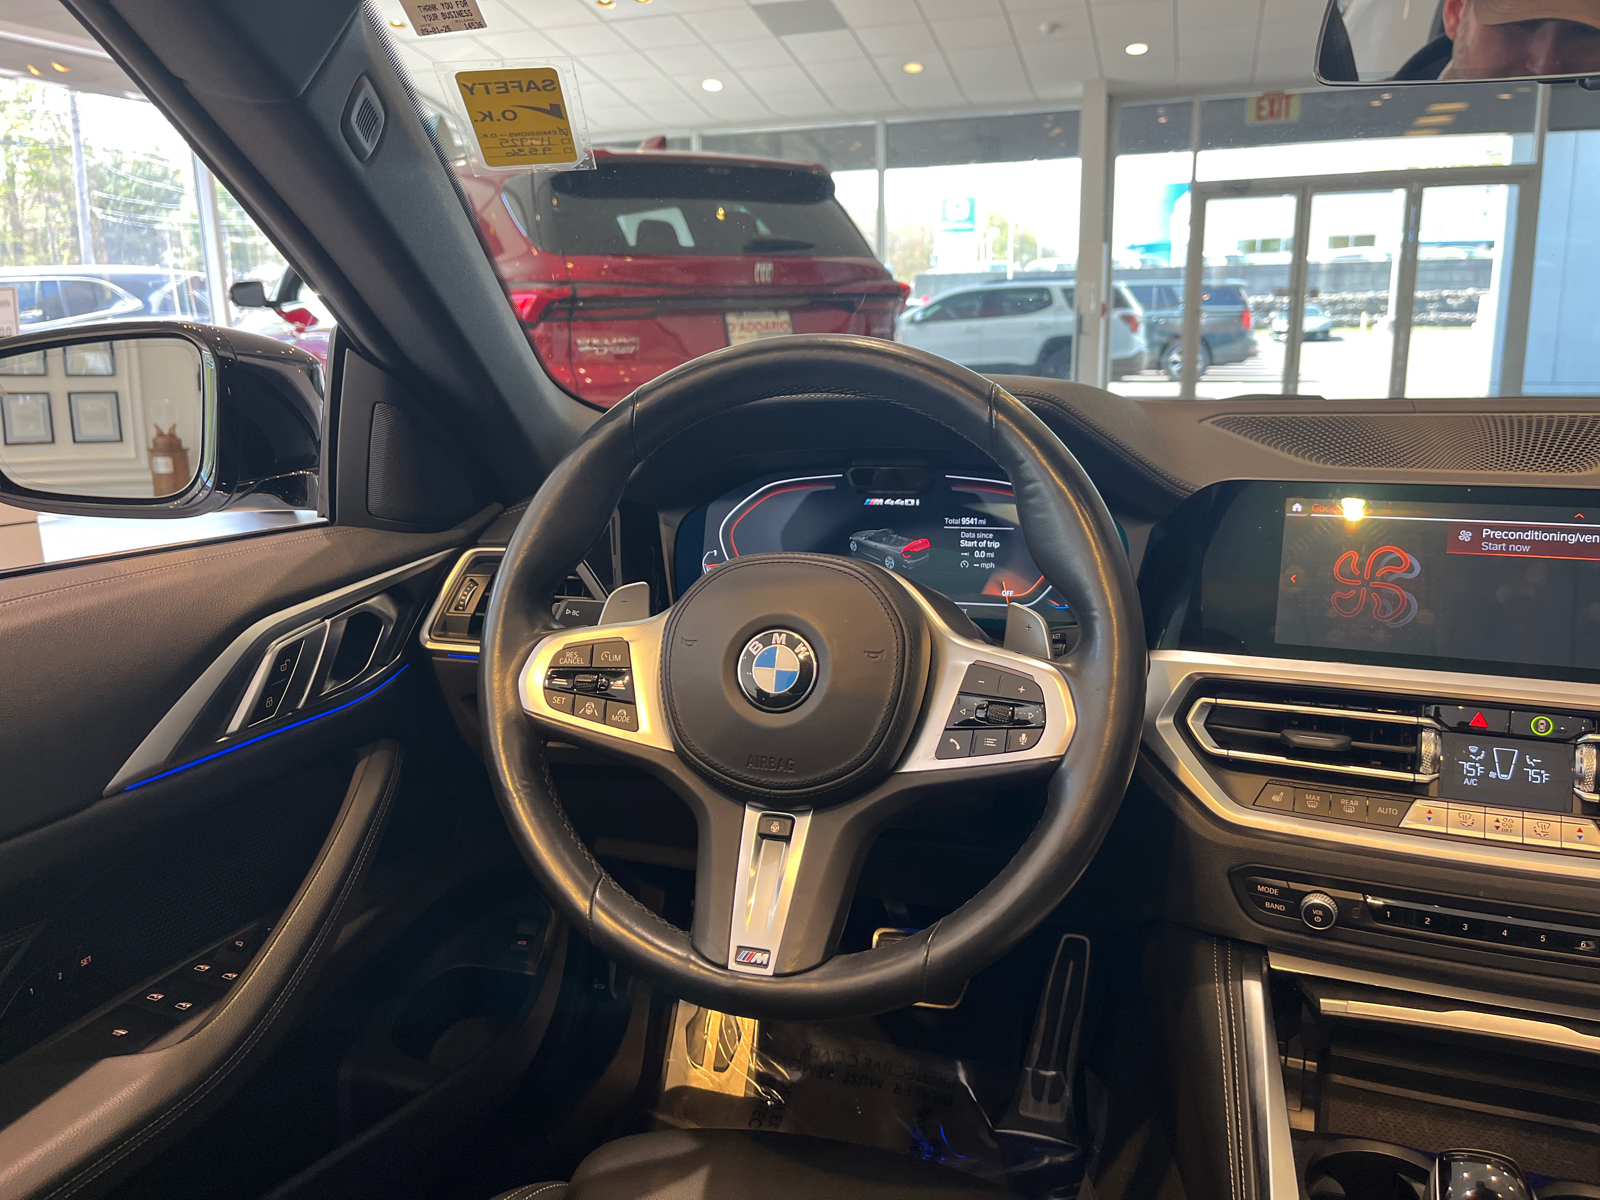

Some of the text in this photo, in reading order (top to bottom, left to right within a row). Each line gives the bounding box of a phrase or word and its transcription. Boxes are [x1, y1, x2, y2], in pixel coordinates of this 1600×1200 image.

[417, 0, 470, 13] THANK YOU FOR
[422, 9, 473, 23] YOUR BUSINESS
[1255, 93, 1295, 122] EXIT
[944, 517, 960, 525] Total
[961, 517, 978, 525] 9541
[960, 540, 1000, 549] Start of trip
[1481, 541, 1531, 553] Start now
[748, 632, 810, 660] BMW
[565, 651, 579, 659] RES
[608, 654, 621, 662] LIM
[559, 657, 585, 665] CANCEL
[552, 696, 566, 705] SET
[611, 714, 631, 723] MODE
[746, 755, 796, 773] AIRBAG
[1463, 777, 1479, 786] A/C
[1305, 793, 1321, 802] MAX
[1340, 798, 1359, 807] REAR
[1376, 806, 1399, 816] AUTO
[1257, 884, 1279, 896] MODE
[1265, 901, 1286, 912] BAND
[1312, 908, 1324, 917] VOL
[1386, 910, 1391, 918] 1
[1424, 917, 1431, 926] 2
[1462, 923, 1468, 931] 3
[1501, 929, 1508, 937] 4
[1540, 934, 1546, 943] 5
[1580, 940, 1587, 949] 6
[80, 955, 92, 967] SET
